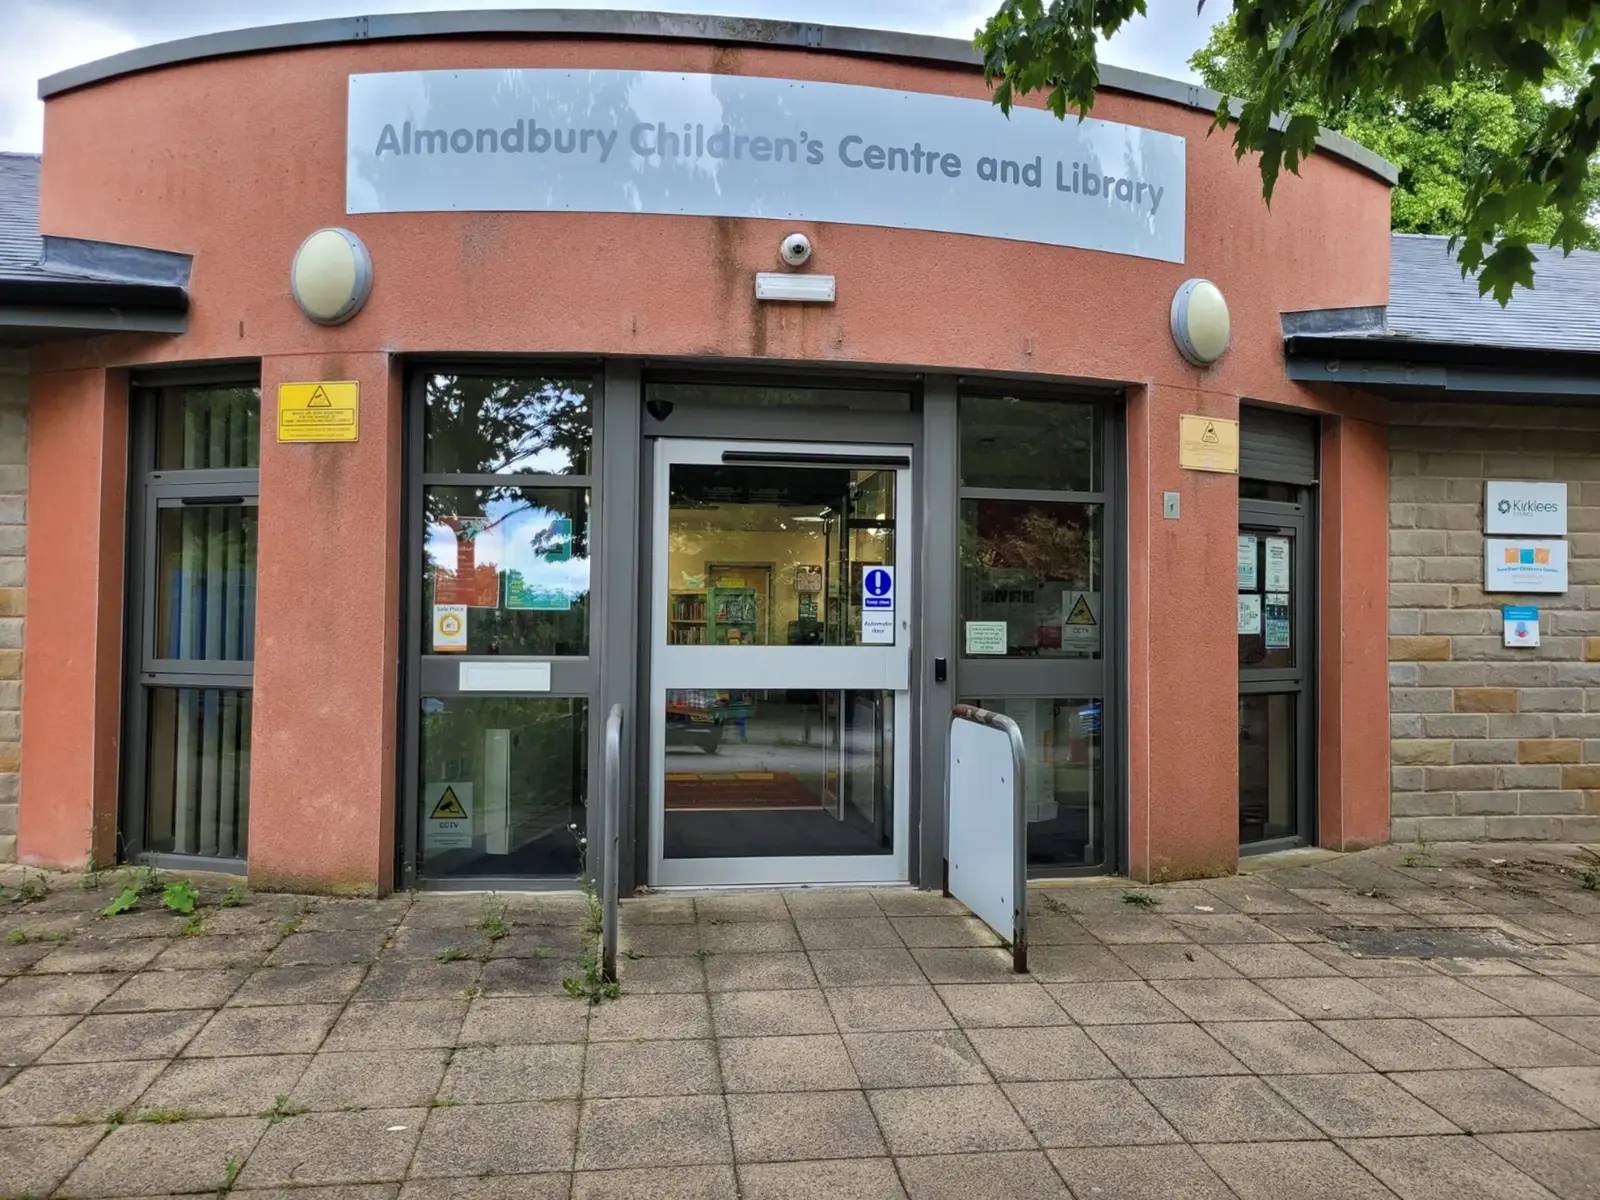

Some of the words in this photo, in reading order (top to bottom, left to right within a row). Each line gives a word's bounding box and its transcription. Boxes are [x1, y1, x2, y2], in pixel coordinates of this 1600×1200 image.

[375, 119, 618, 163] Almondbury
[629, 122, 825, 166] Children's
[838, 135, 962, 178] Centre
[976, 156, 1042, 188] and
[1056, 161, 1165, 215] Library
[1513, 499, 1558, 513] Kirklees
[439, 821, 459, 829] CCTV
